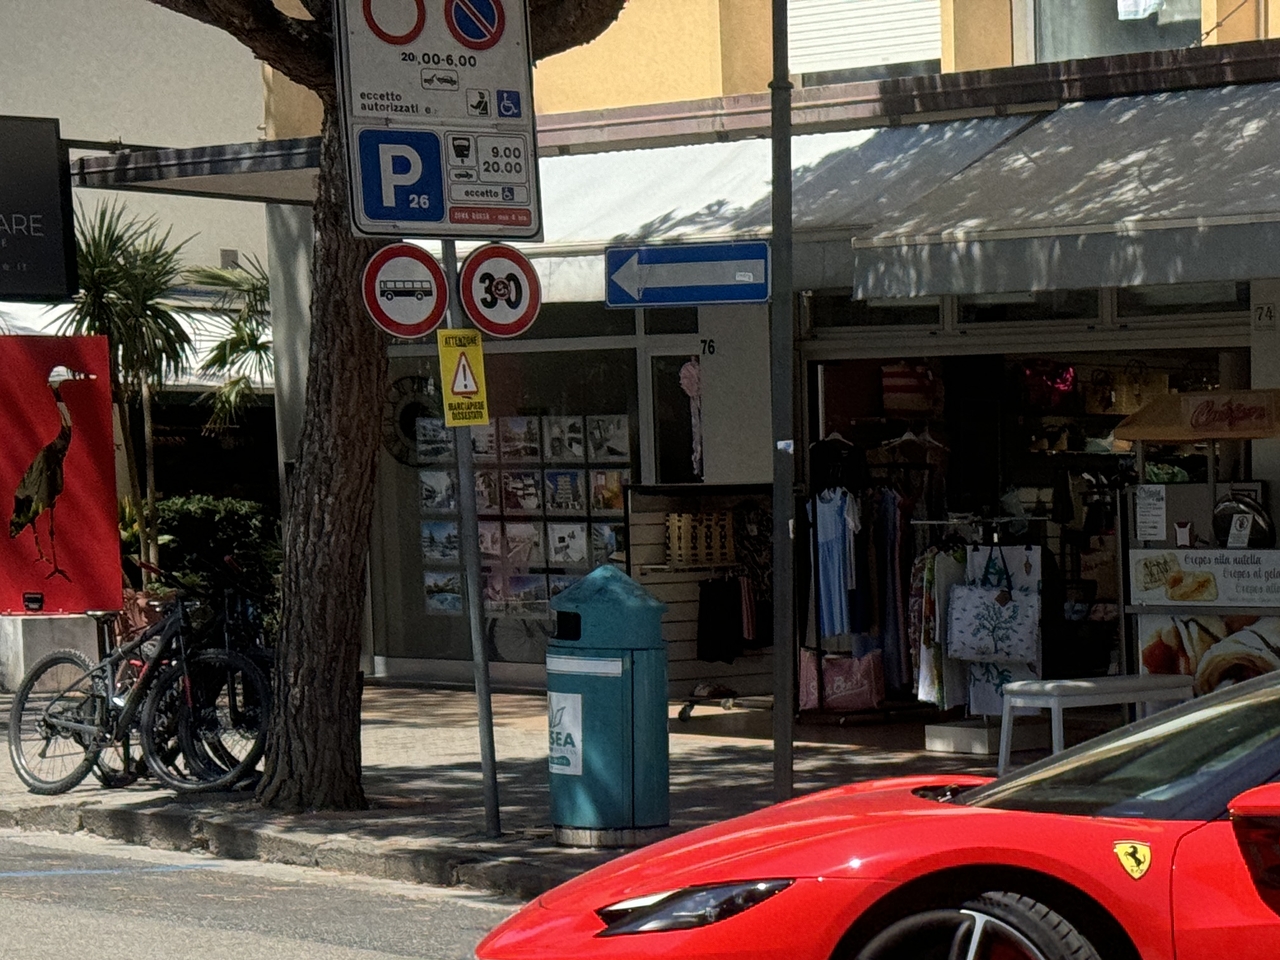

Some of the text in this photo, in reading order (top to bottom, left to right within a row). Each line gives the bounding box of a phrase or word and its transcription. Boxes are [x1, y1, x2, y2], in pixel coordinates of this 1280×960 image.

[360, 91, 402, 101] eccetto
[361, 102, 418, 113] autorizzati
[483, 161, 522, 174] 20.00
[378, 144, 422, 207] P
[464, 189, 499, 198] eccetto
[409, 194, 430, 209] 26
[479, 272, 522, 310] 30
[1256, 306, 1274, 320] 74
[700, 339, 716, 354] 76
